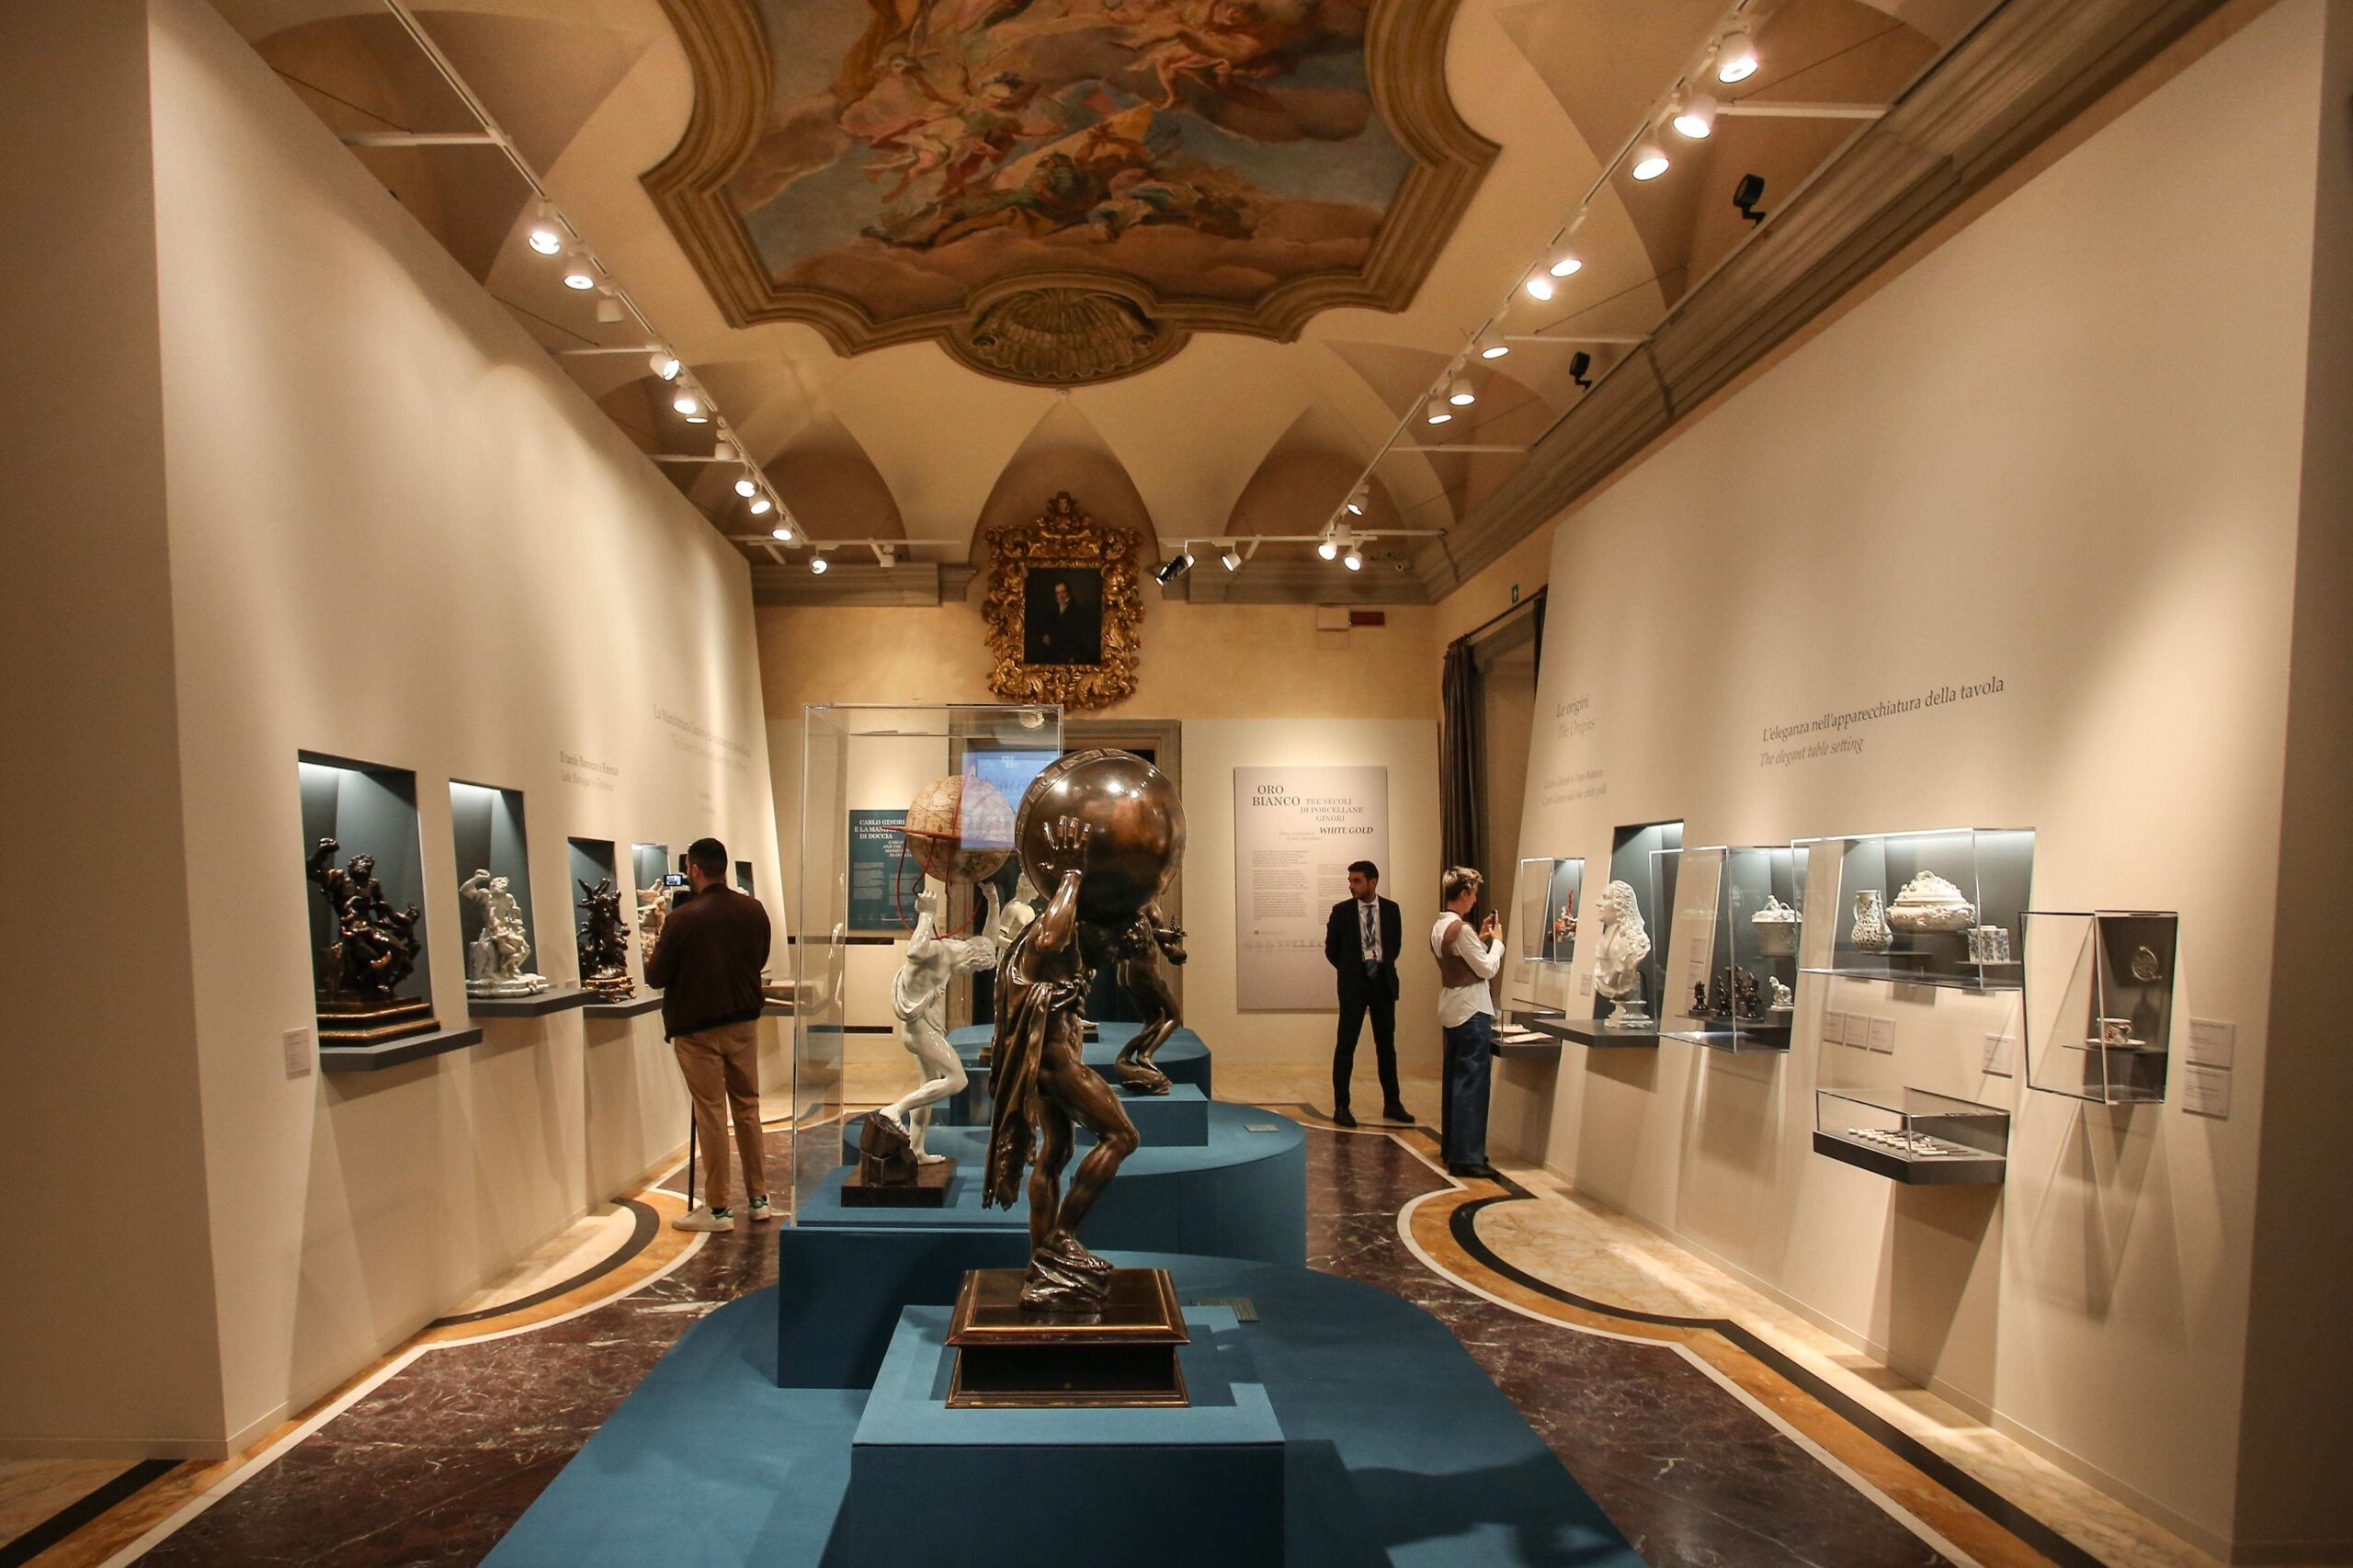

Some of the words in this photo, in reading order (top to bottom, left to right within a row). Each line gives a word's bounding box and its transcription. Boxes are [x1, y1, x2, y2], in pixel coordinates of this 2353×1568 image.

[1762, 725, 1809, 742] L'eleganza
[1812, 699, 1921, 732] nell'apparecchiatura
[1925, 687, 1956, 707] della
[1961, 676, 2004, 699] tavola
[1760, 752, 1774, 767] The
[1775, 746, 1805, 767] elegant
[1807, 740, 1829, 758] table
[1830, 736, 1864, 755] setting
[1257, 784, 1284, 795] ORO
[1252, 796, 1301, 807] BIANCO
[1320, 826, 1347, 835] WHITE
[1348, 826, 1374, 835] GOLD
